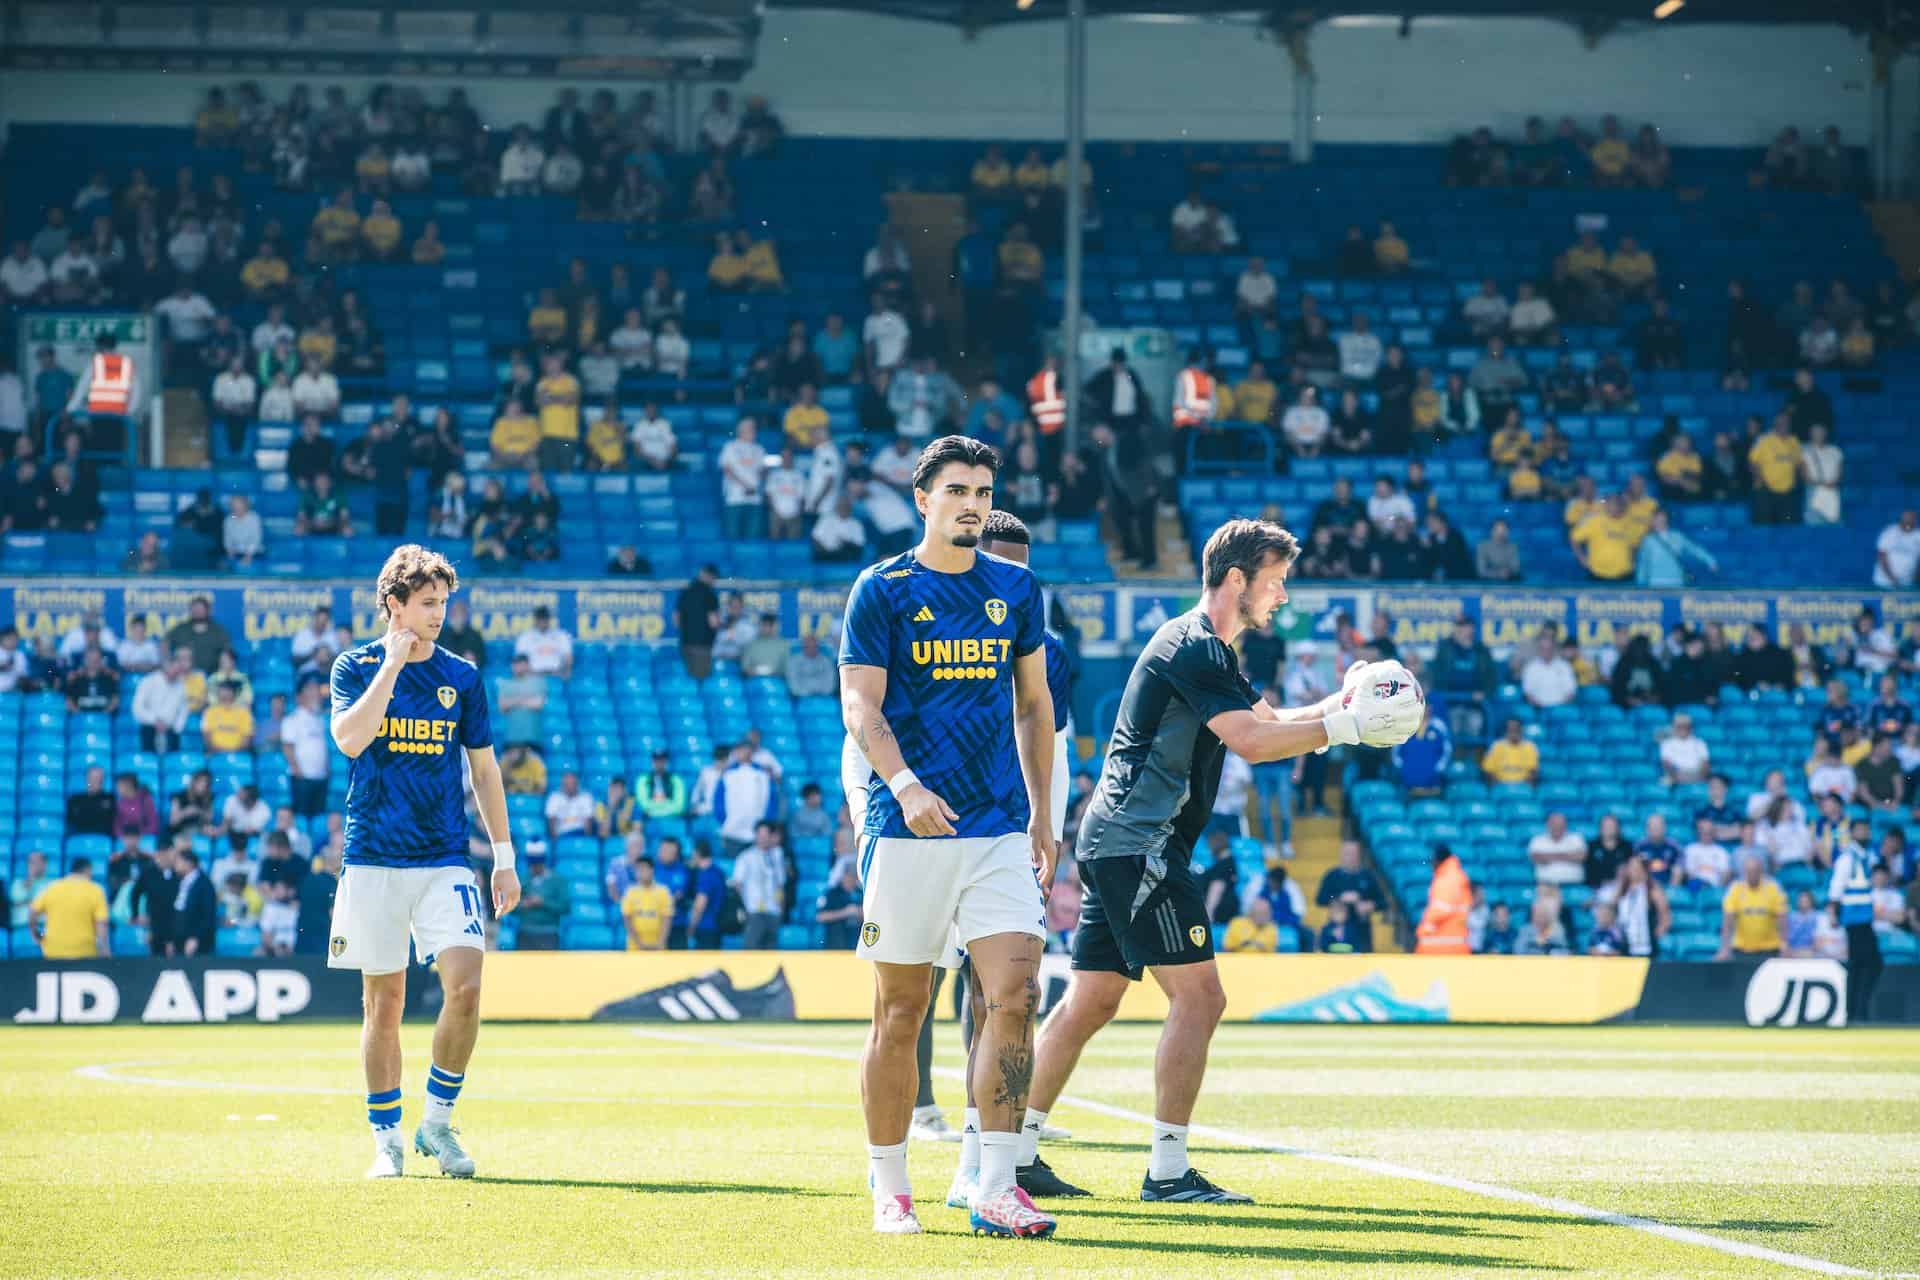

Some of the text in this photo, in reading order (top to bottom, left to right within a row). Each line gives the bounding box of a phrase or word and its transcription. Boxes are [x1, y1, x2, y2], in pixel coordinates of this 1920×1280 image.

[56, 319, 117, 338] EXIT
[578, 613, 666, 641] LAND
[910, 638, 1012, 665] UNIBET
[453, 884, 482, 918] 11
[13, 968, 312, 1024] JD APP
[1764, 977, 1839, 1026] JD
